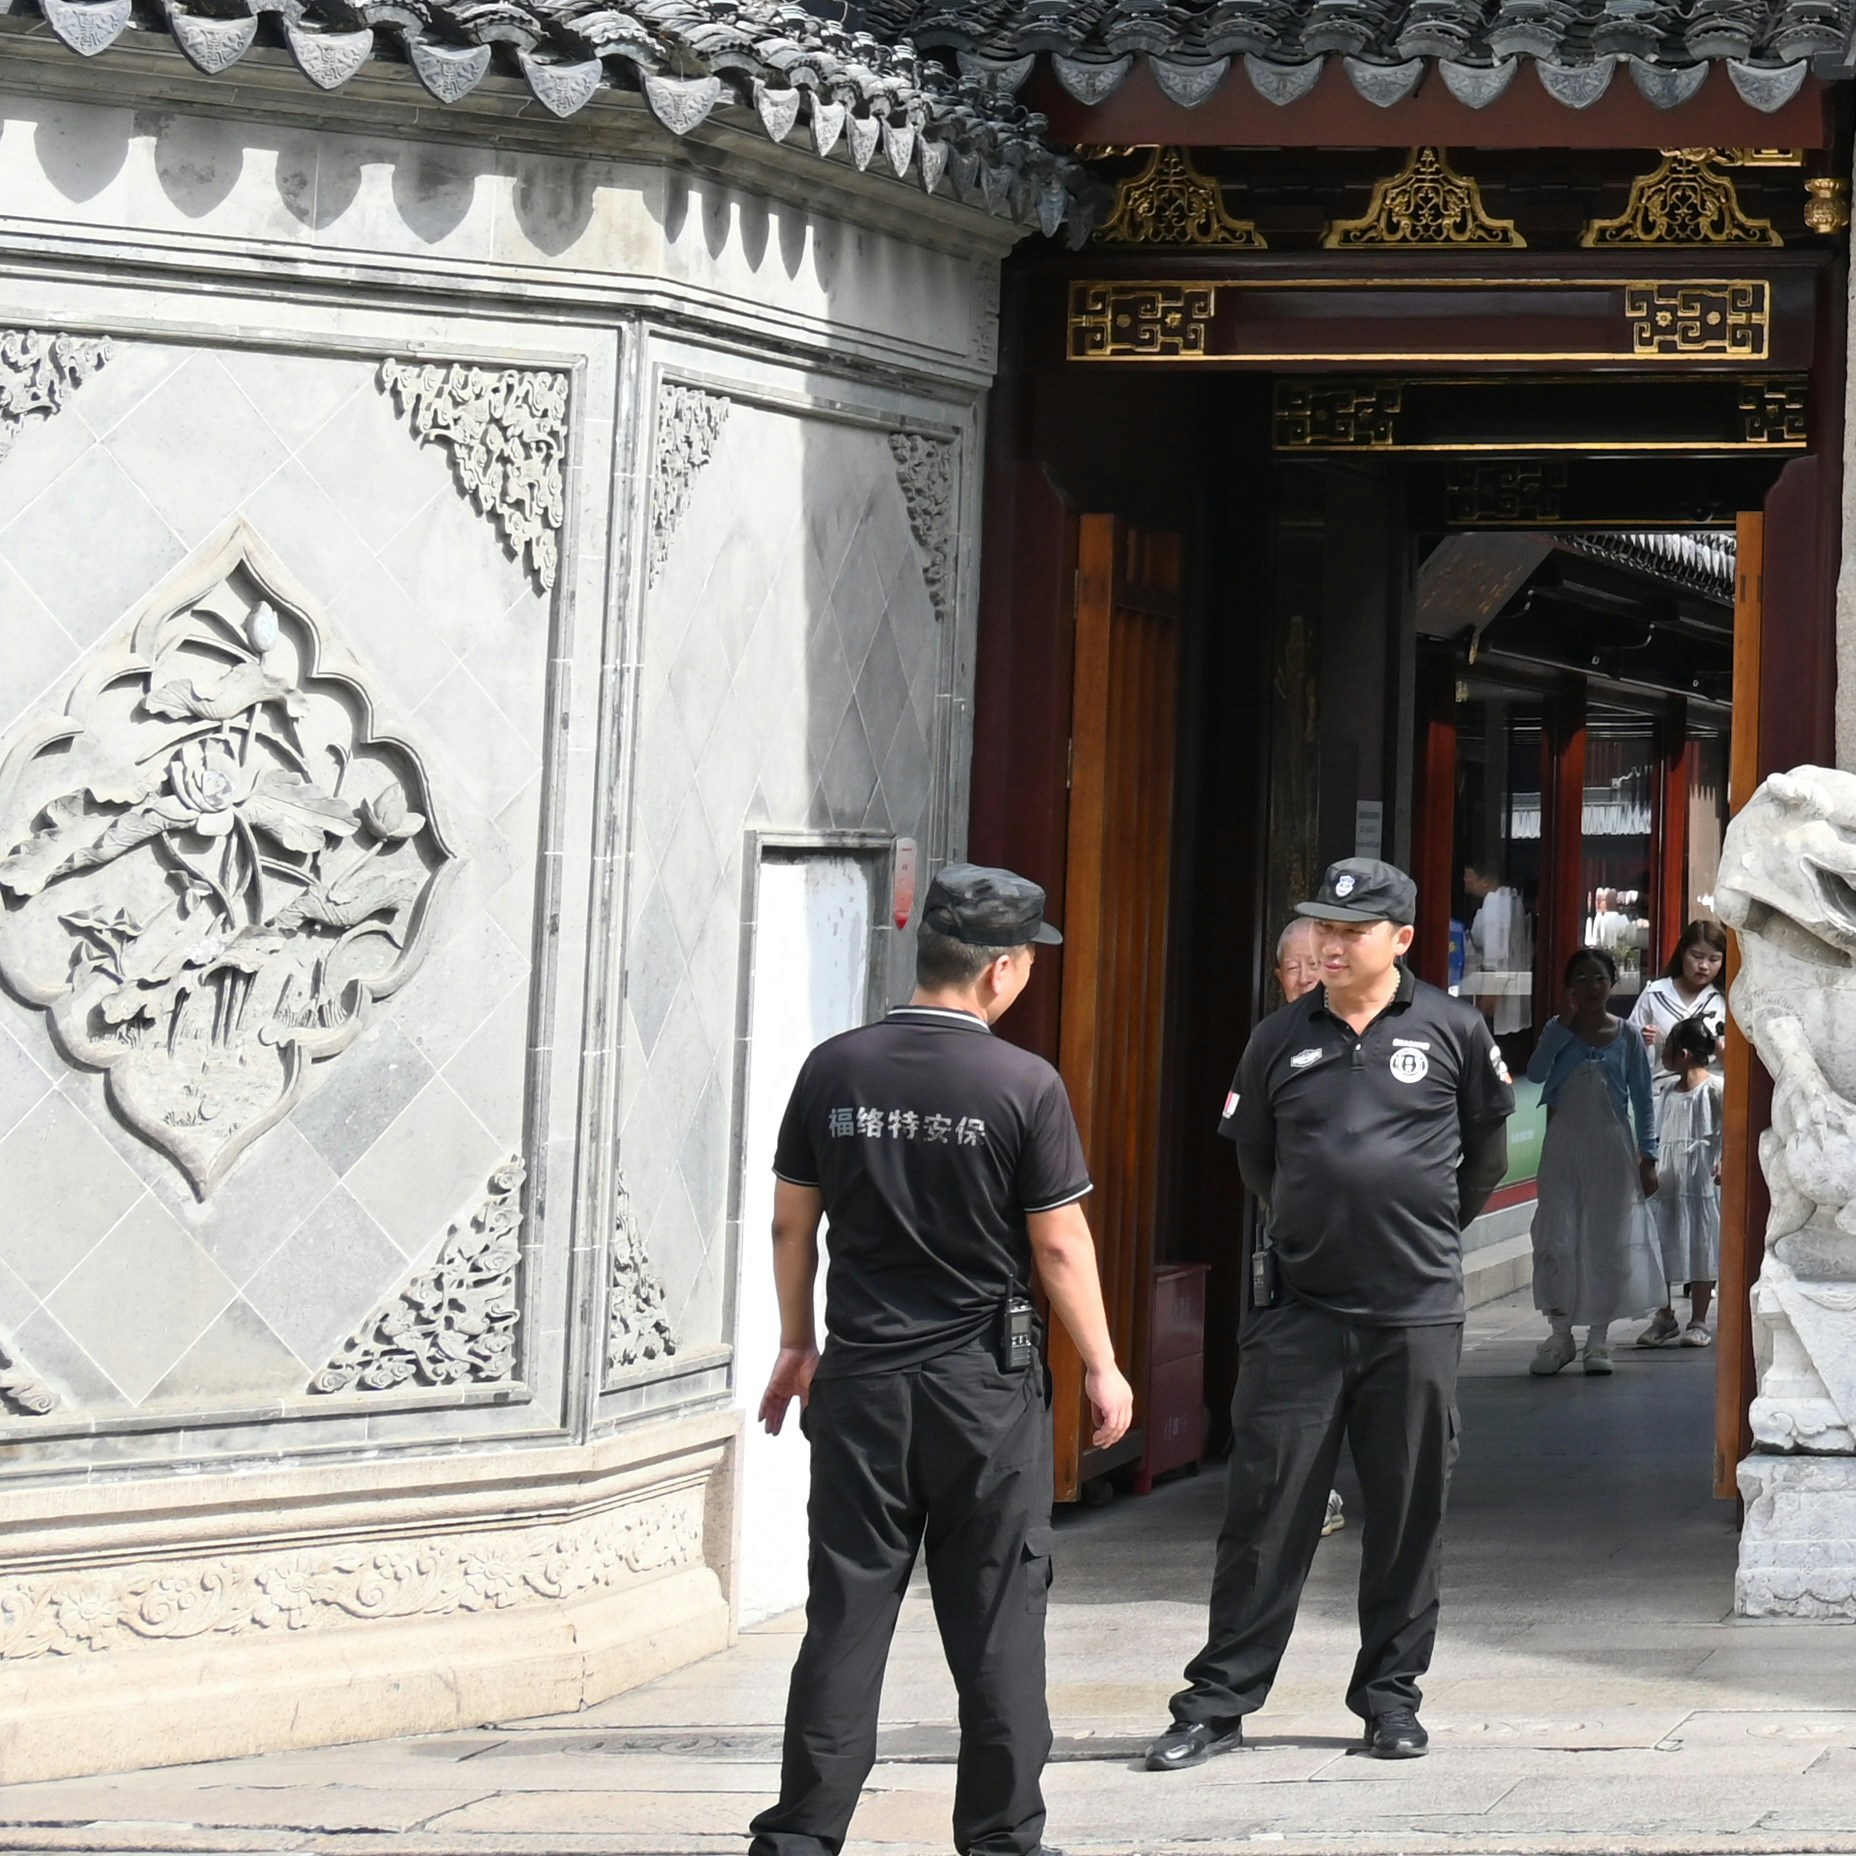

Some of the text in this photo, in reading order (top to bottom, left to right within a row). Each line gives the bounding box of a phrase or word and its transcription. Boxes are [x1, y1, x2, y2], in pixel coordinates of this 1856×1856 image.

[828, 1106, 986, 1146] 福络特安保
